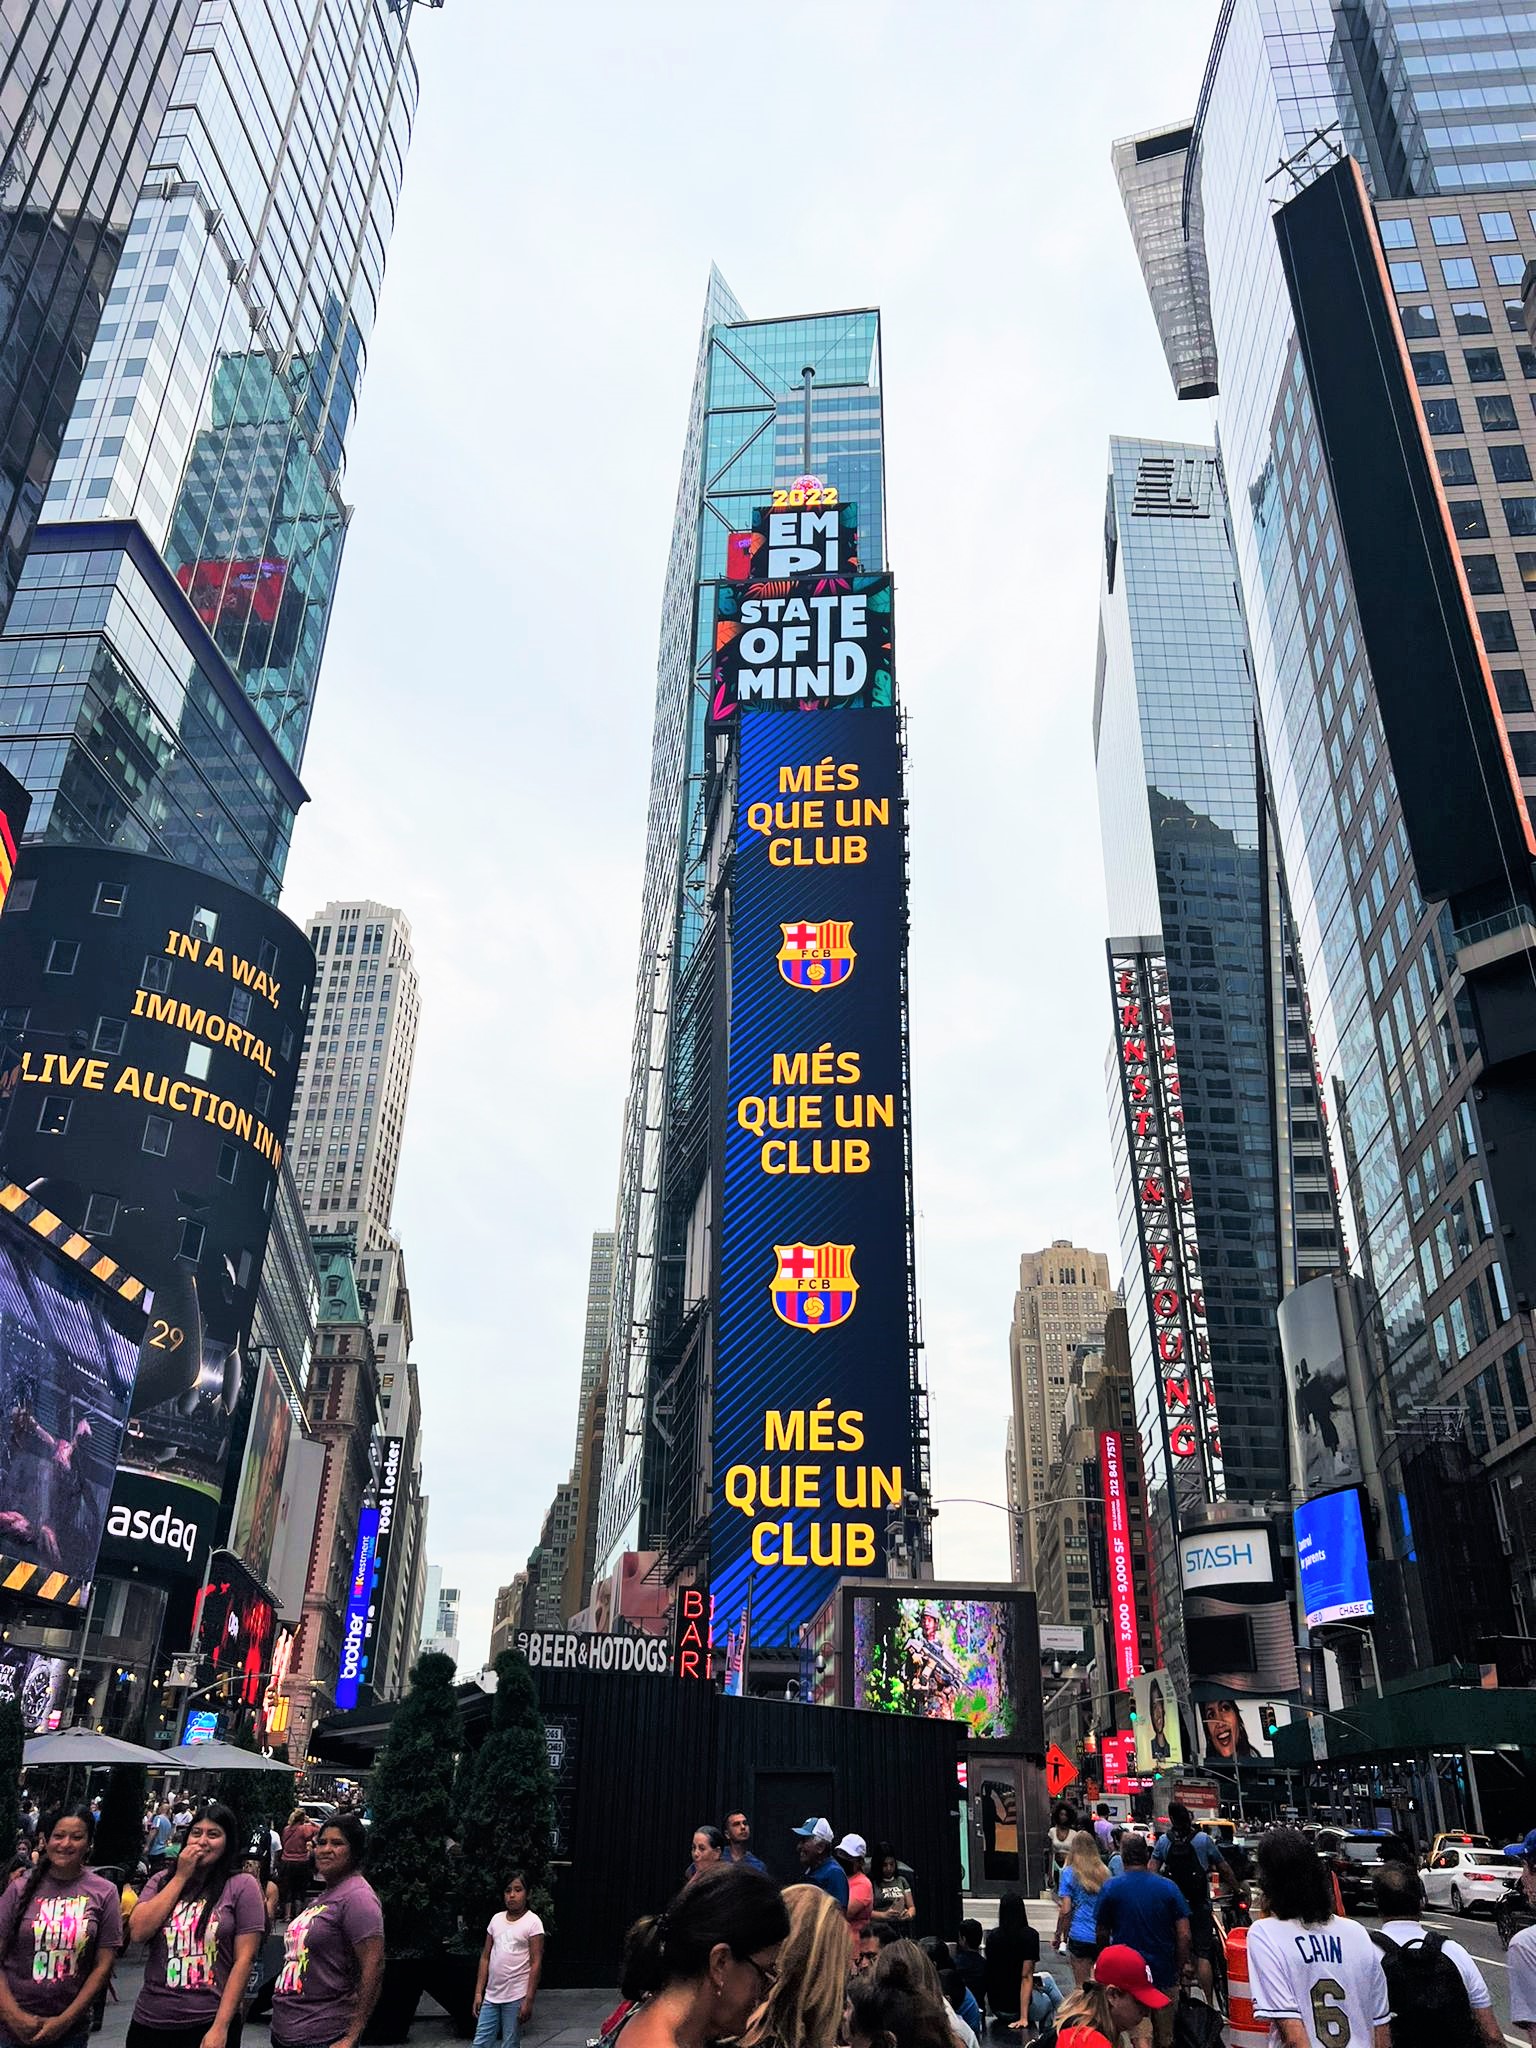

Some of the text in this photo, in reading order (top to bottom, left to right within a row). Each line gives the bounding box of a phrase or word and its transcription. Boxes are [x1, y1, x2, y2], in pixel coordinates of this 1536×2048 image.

[772, 487, 838, 507] 2022
[769, 510, 839, 547] EM
[768, 540, 839, 578] PI
[739, 626, 811, 665] OF
[740, 595, 867, 663] STATE
[737, 641, 867, 701] MIND
[778, 757, 859, 793] MÉS
[747, 798, 889, 833] QUE UN
[768, 835, 868, 867] CLUB
[164, 929, 282, 1010] IN A WAY,
[801, 949, 831, 959] FCB
[130, 989, 278, 1077] IMMORTAL.
[772, 1042, 861, 1085] MÉS
[21, 1052, 110, 1093] LIVE
[113, 1066, 253, 1142] AUCTION
[253, 1120, 274, 1160] IN
[737, 1093, 895, 1137] QUE UN
[760, 1138, 871, 1175] CLUB
[798, 1279, 831, 1290] FCB
[149, 1320, 185, 1352] 29
[1148, 1244, 1197, 1457] YOUNG
[764, 1397, 865, 1452] MÉS
[380, 1440, 401, 1494] Locker
[1106, 1436, 1119, 1497] 212 841 7517
[725, 1464, 902, 1517] QUE UN
[107, 1505, 197, 1562] asdaq
[751, 1521, 876, 1567] CLUB
[1114, 1538, 1124, 1553] SF
[1115, 1555, 1128, 1593] 9,000
[1186, 1543, 1252, 1574] STASH
[1119, 1603, 1132, 1641] 3,000
[1339, 1603, 1365, 1616] CHASE
[340, 1612, 364, 1679] brother
[680, 1590, 704, 1679] BAR
[588, 1635, 668, 1673] HOTDOGS
[38, 1895, 88, 1921] NEW
[1295, 1934, 1343, 1964] CAIN
[1310, 1978, 1351, 2048] 6
